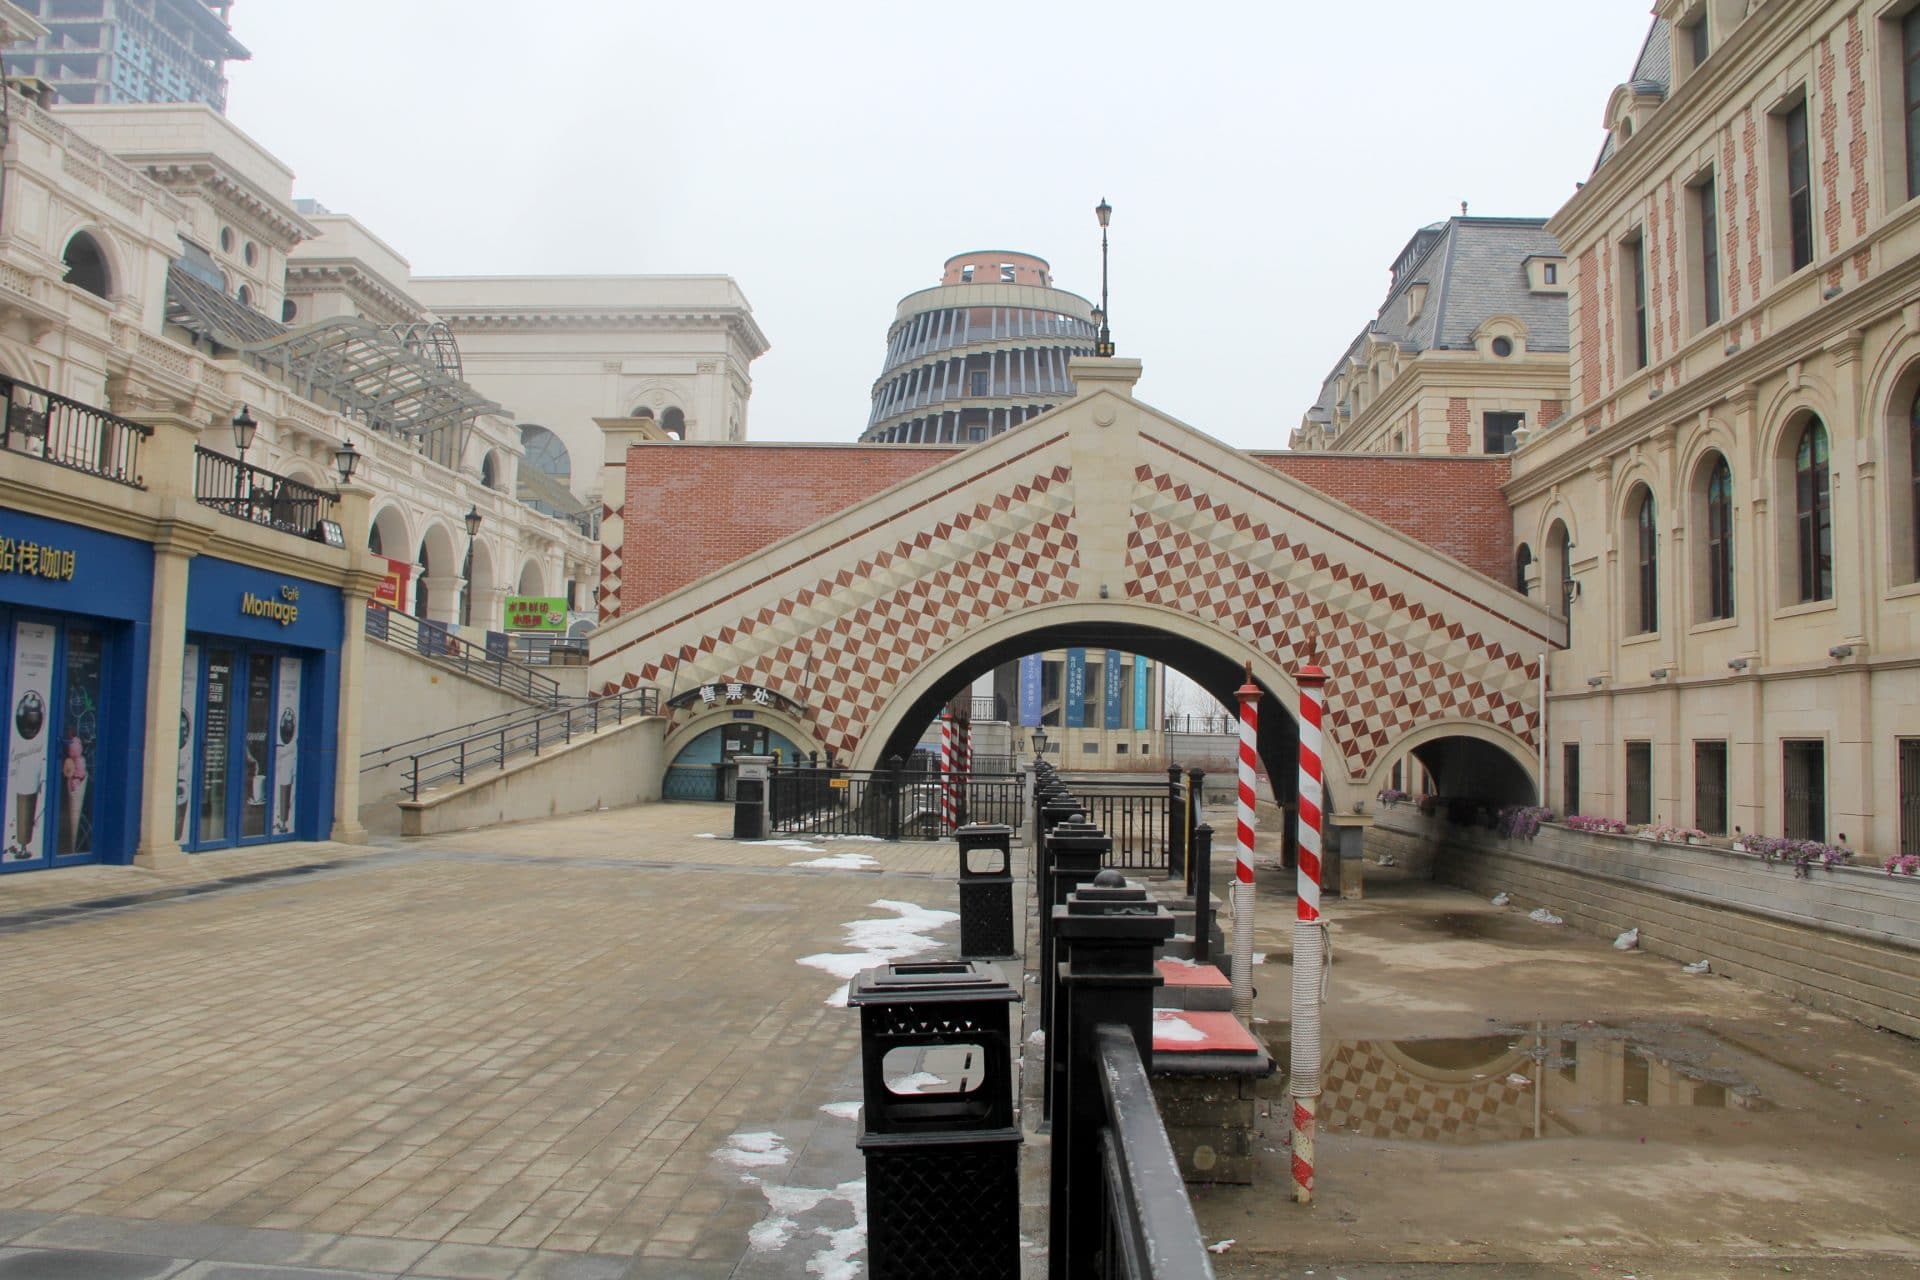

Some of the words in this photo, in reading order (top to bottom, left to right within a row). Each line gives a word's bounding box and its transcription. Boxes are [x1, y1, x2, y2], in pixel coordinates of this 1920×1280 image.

[242, 592, 298, 626] Montage
[699, 683, 770, 706] 售票处
